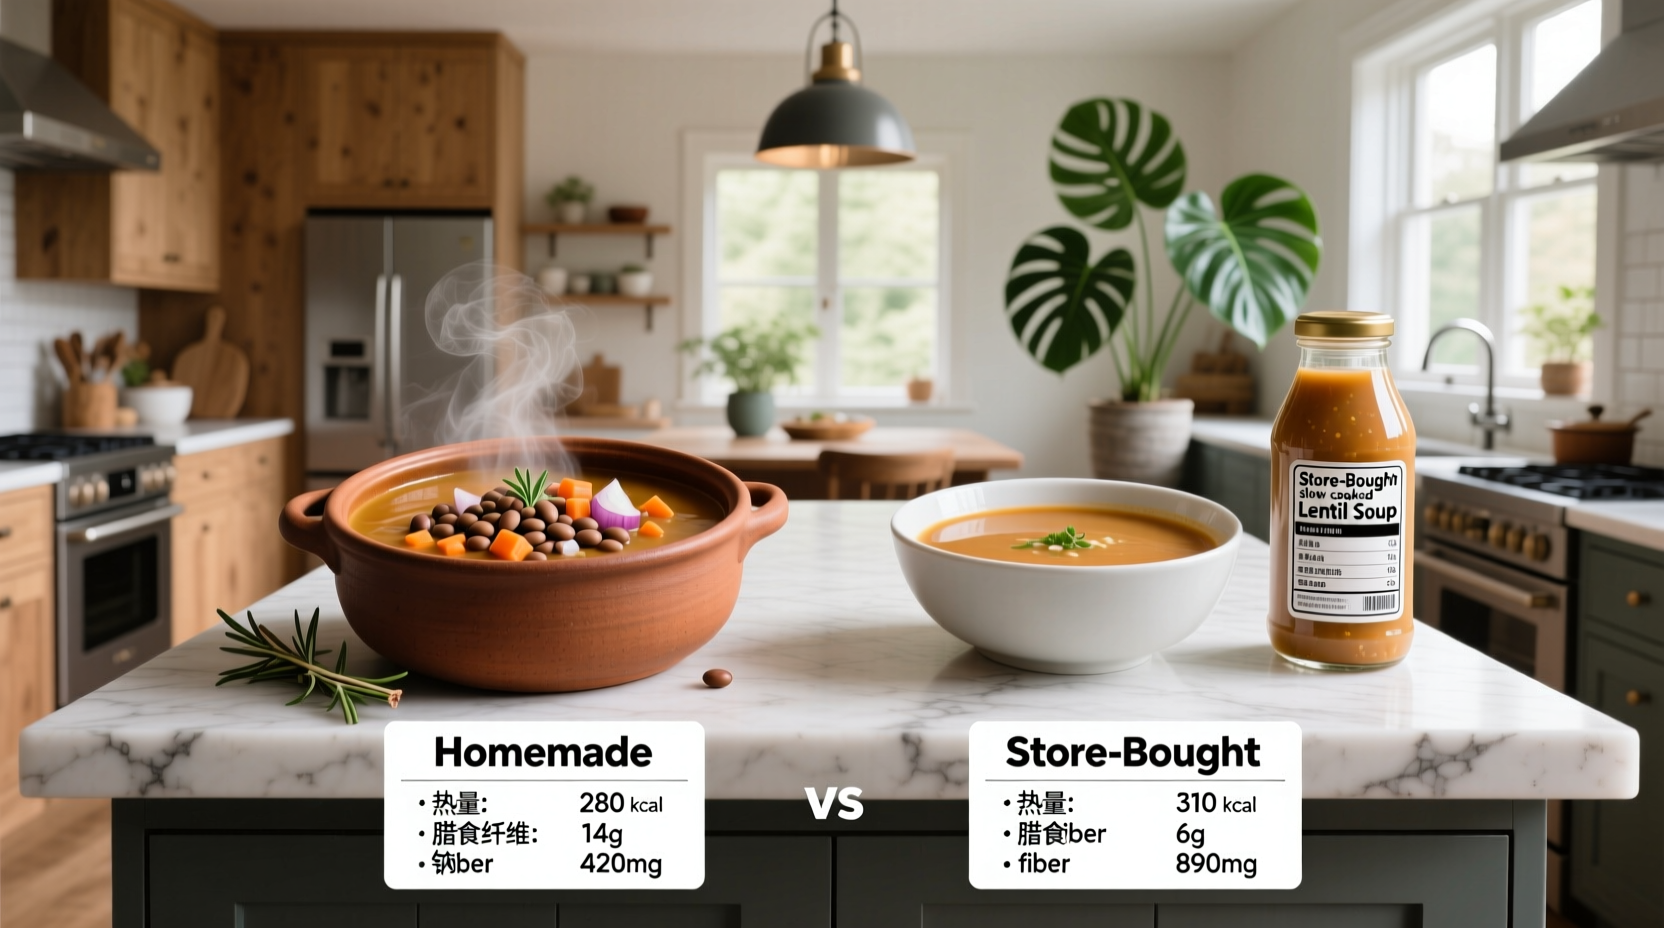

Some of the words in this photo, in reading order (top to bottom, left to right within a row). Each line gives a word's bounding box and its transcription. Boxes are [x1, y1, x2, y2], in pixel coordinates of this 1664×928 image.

[1299, 487, 1326, 499] slow
[1298, 501, 1347, 520] Lentil
[1353, 502, 1398, 522] Soup
